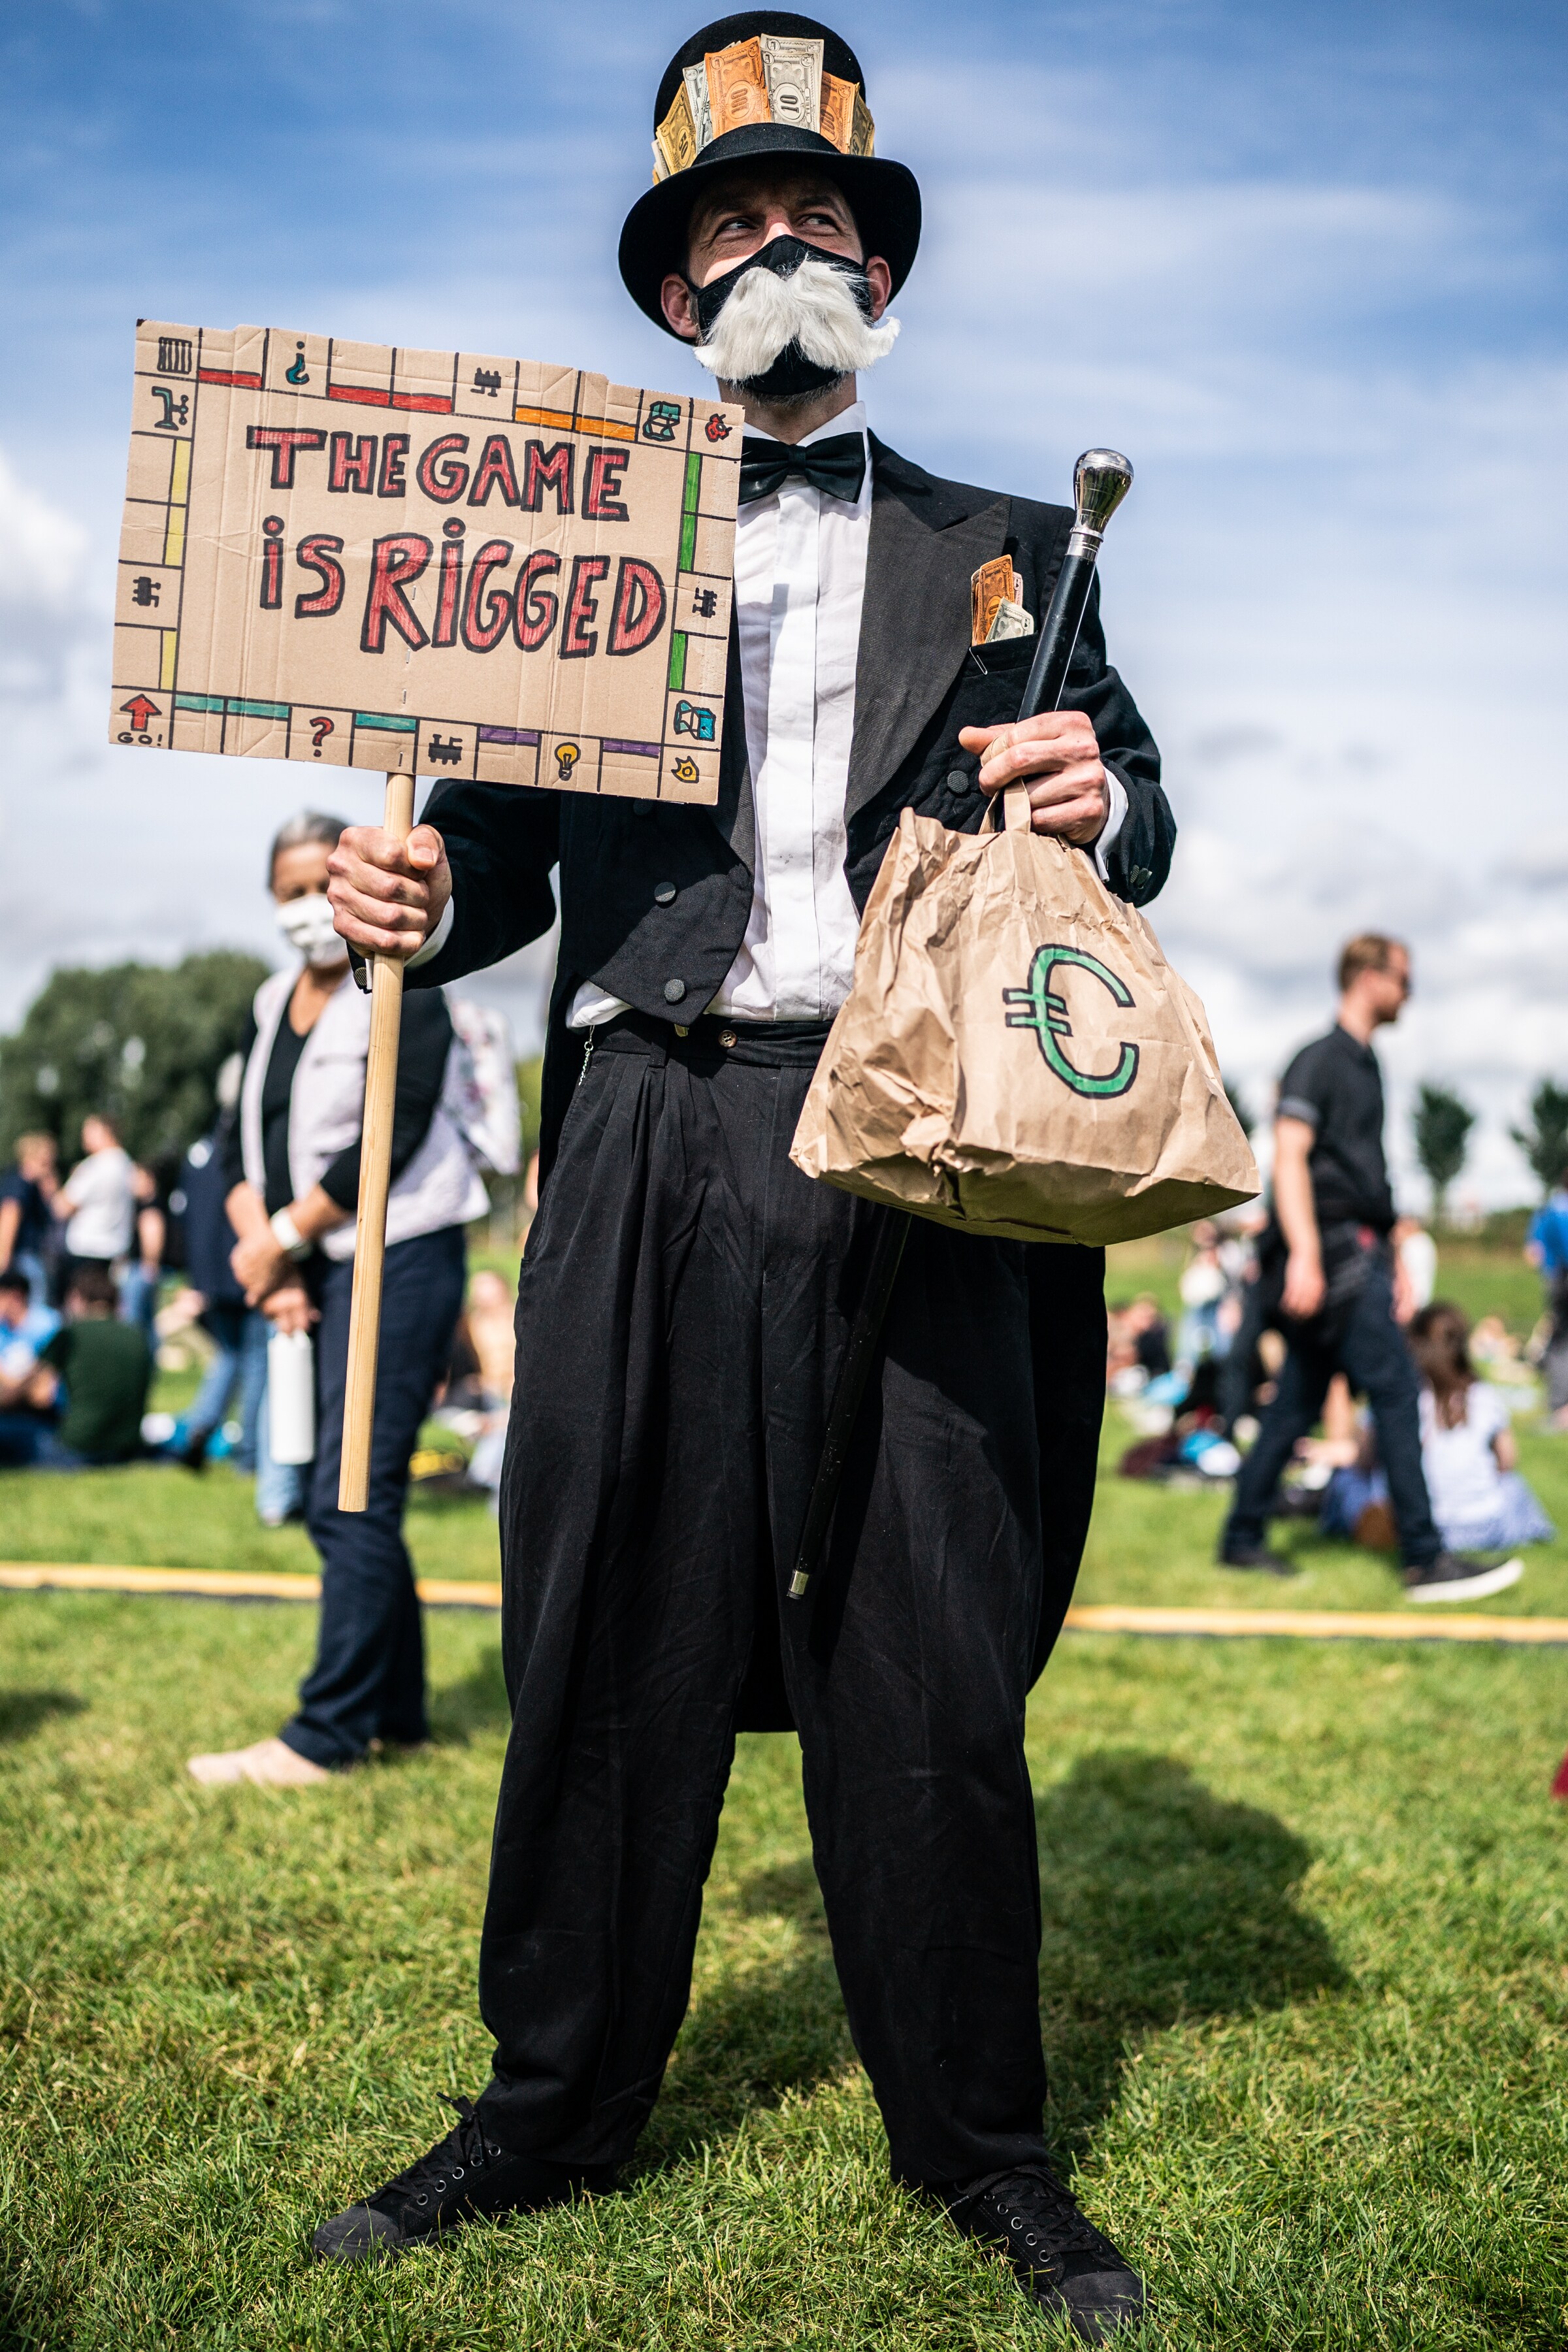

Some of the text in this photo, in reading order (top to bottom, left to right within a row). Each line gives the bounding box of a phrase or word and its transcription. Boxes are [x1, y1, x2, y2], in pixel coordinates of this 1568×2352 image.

[731, 88, 749, 114] 100
[780, 94, 799, 113] 10
[679, 132, 689, 159] 50
[246, 425, 630, 521] THE GAME
[118, 732, 163, 746] GO!
